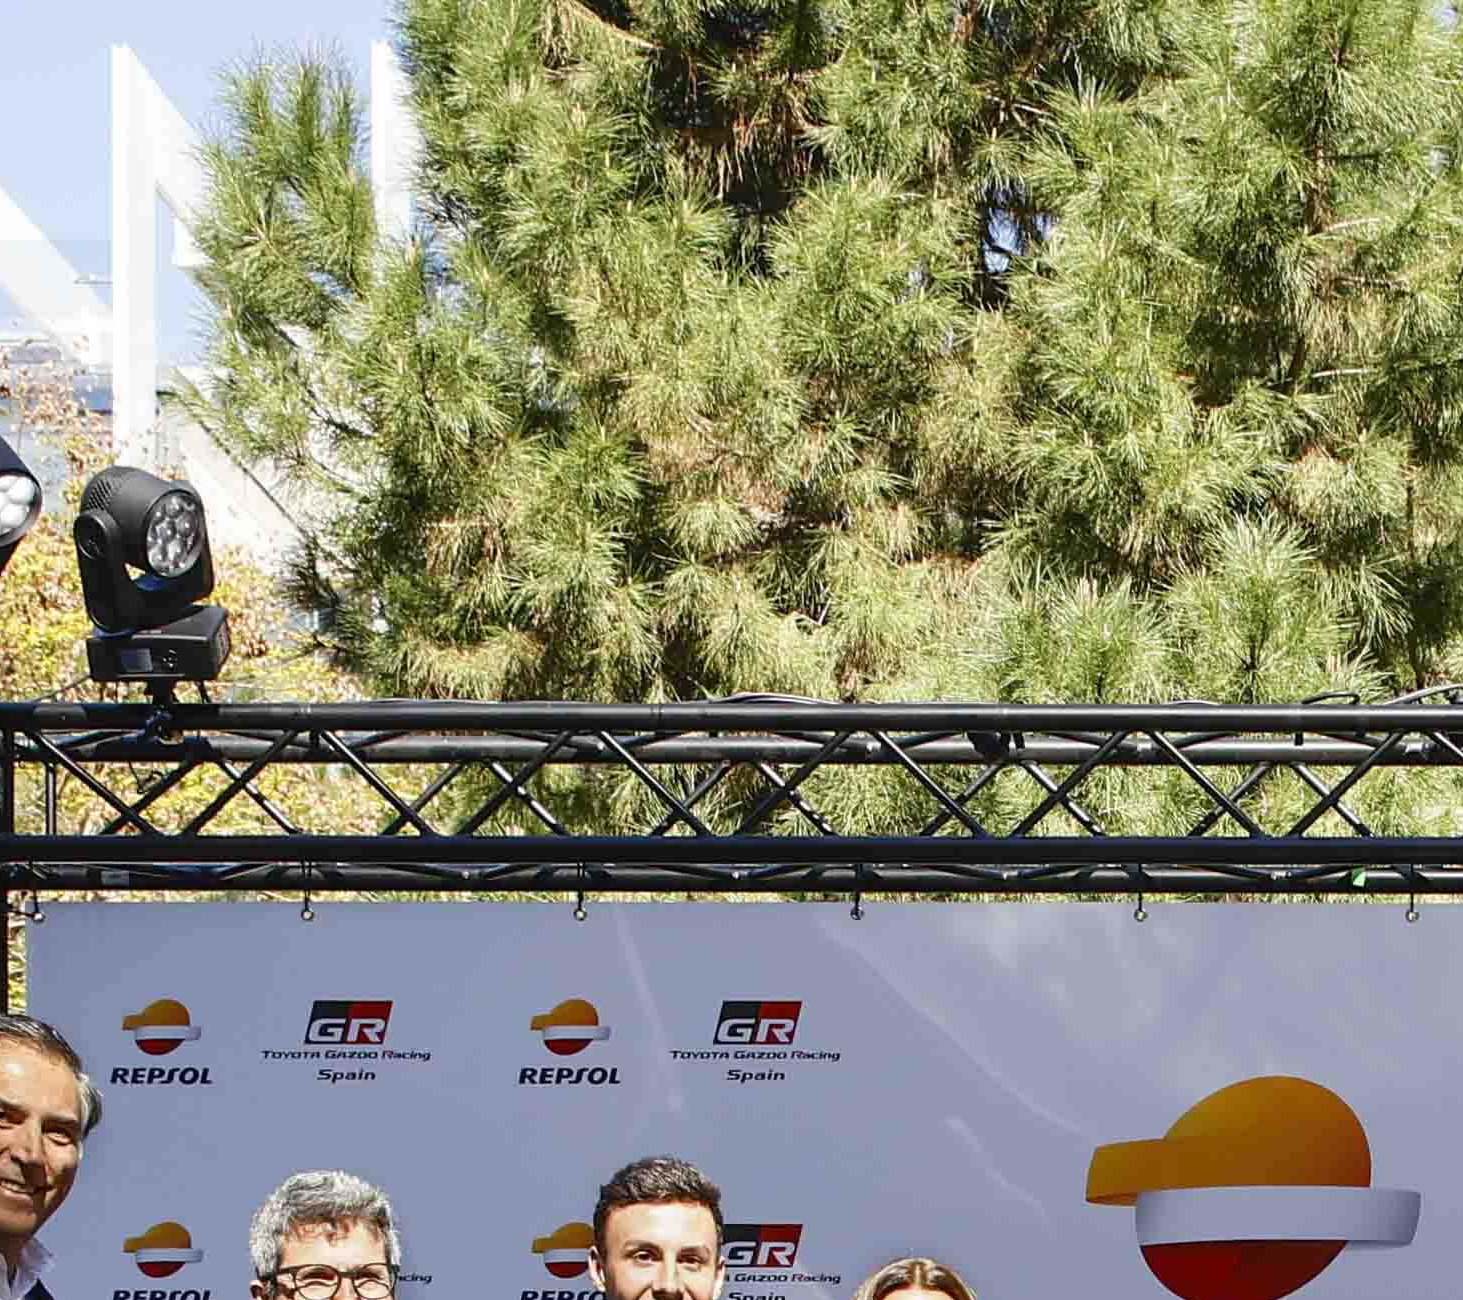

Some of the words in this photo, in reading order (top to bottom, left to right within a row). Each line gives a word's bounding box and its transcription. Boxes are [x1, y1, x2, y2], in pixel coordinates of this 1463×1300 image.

[308, 1018, 387, 1043] GR
[718, 1018, 796, 1043] GR
[262, 1051, 320, 1059] TOYOTA
[325, 1050, 378, 1059] GAZOO
[381, 1050, 431, 1062] Racing
[670, 1051, 729, 1059] TOYOTA
[734, 1051, 787, 1059] GAZOO
[791, 1051, 840, 1062] Racing
[110, 1067, 212, 1085] REPSOL
[317, 1069, 375, 1084] Spain
[519, 1067, 620, 1085] REPSOL
[727, 1070, 785, 1084] Spain
[399, 1273, 433, 1284] cing
[734, 1274, 788, 1282] GAZOO
[791, 1274, 841, 1285] Racing
